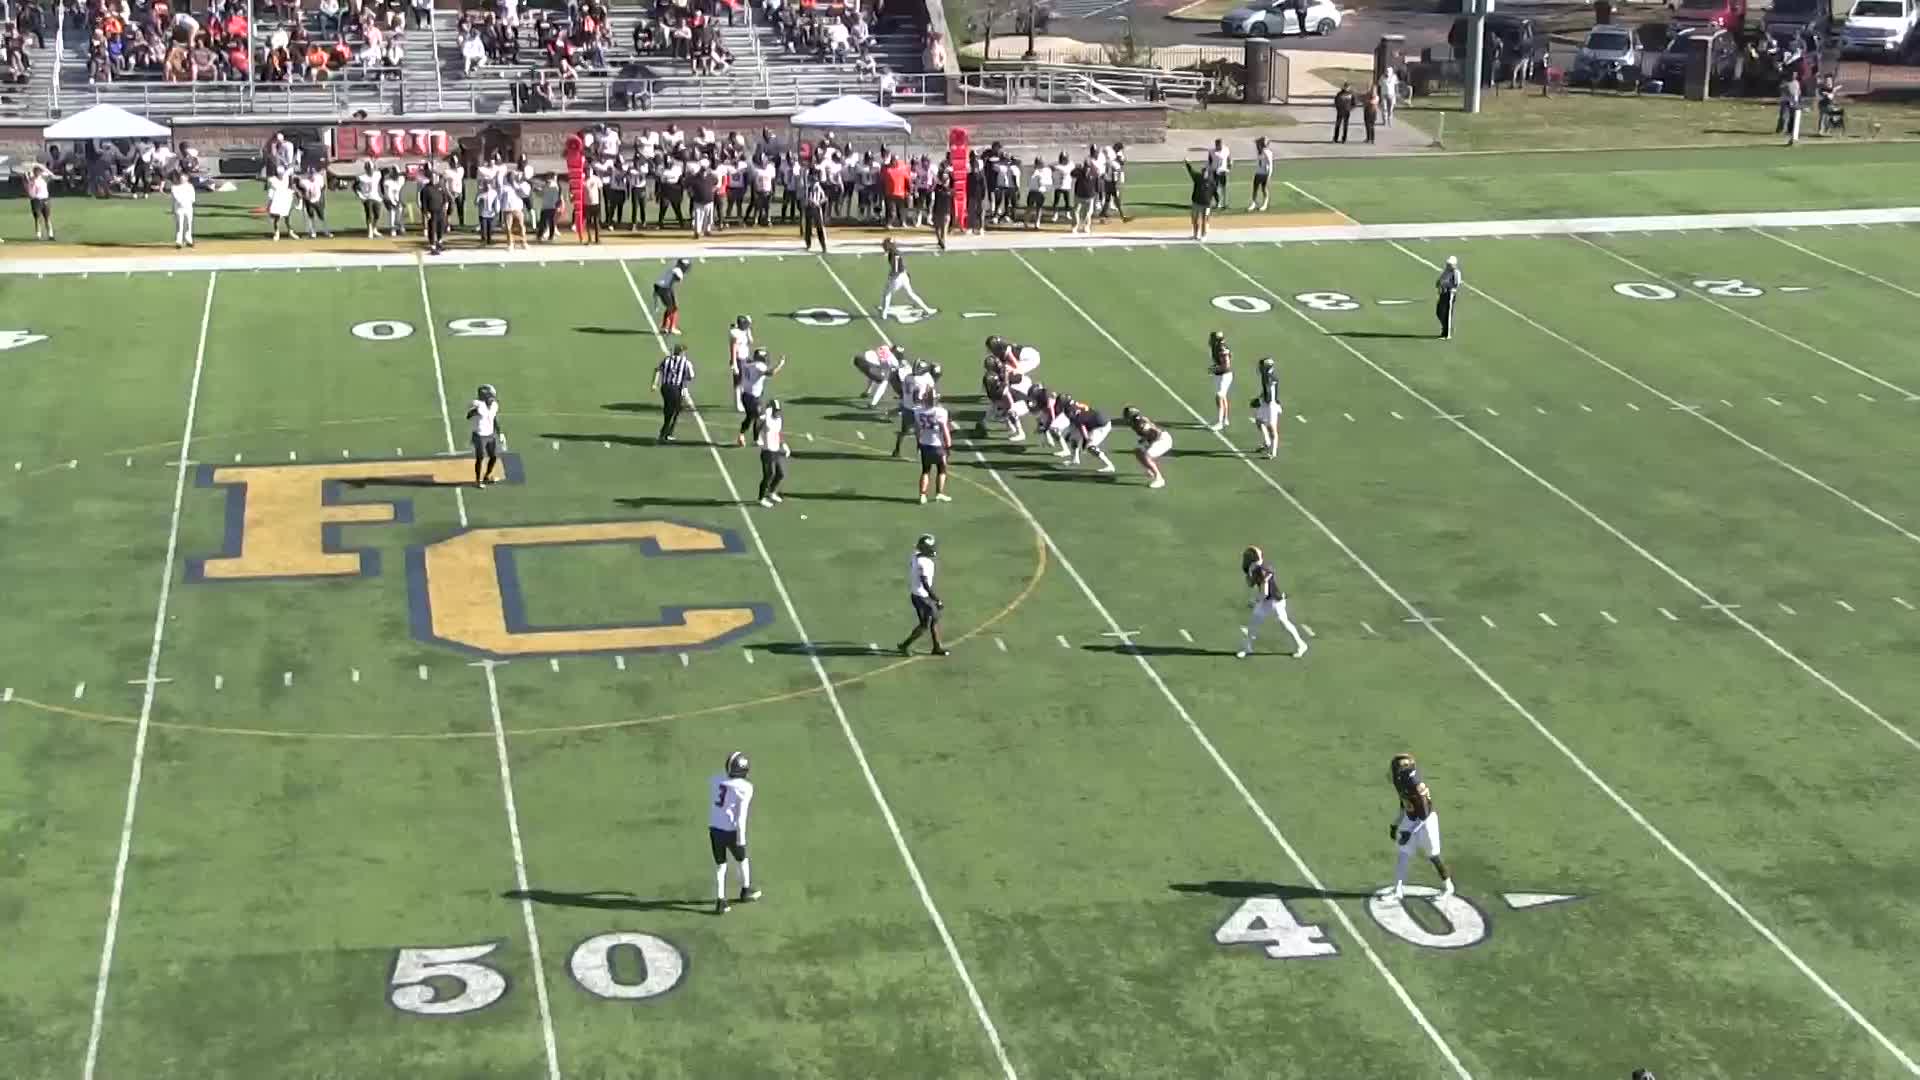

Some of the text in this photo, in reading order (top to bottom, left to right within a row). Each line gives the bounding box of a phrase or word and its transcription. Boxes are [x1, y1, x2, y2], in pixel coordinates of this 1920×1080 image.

[1613, 279, 1763, 300] 20
[1211, 292, 1361, 313] 30
[350, 318, 509, 341] 50
[184, 452, 774, 656] FC
[714, 784, 728, 808] 3
[1213, 884, 1488, 959] 40
[390, 931, 684, 1015] 50
